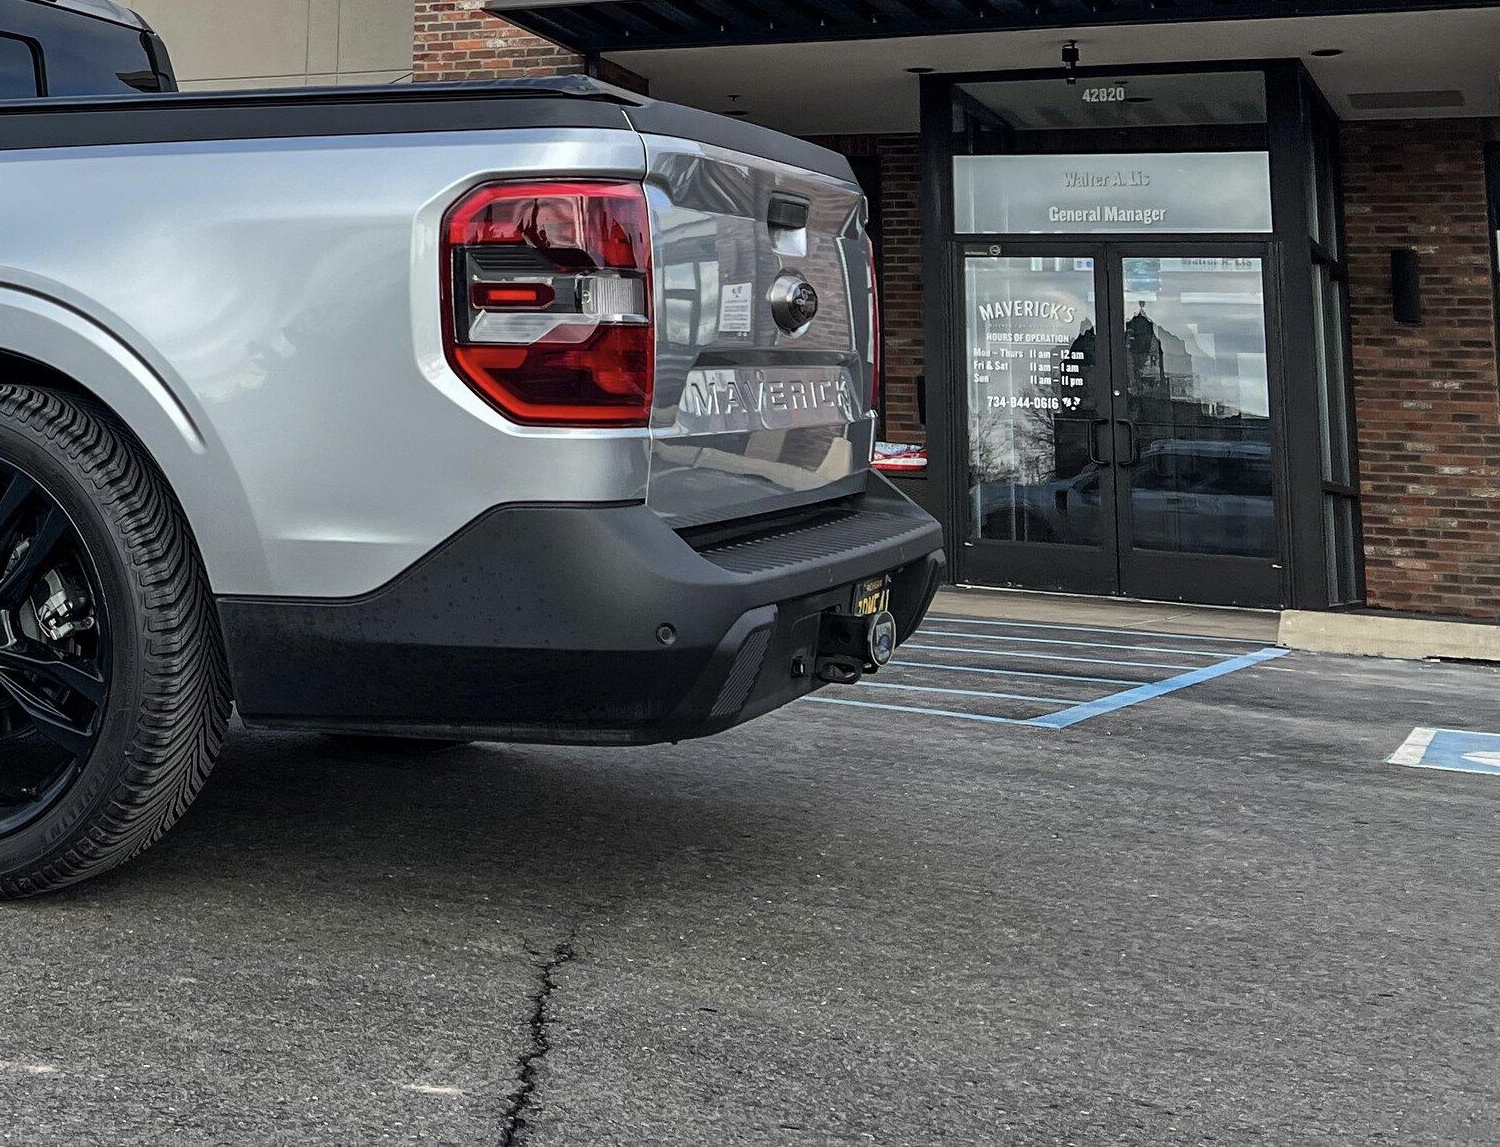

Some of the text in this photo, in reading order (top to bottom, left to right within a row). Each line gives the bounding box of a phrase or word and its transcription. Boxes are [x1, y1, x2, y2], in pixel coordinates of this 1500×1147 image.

[1048, 206, 1167, 225] General Manager
[979, 300, 1076, 323] MAVERICK'S
[987, 333, 1070, 343] HOURS OF OPERATION
[1000, 348, 1024, 358] Thurs
[1038, 351, 1051, 359] am
[1060, 349, 1070, 359] 12
[1071, 352, 1084, 360] am
[973, 361, 984, 370] Fri
[986, 361, 994, 371] &
[995, 361, 1008, 371] Sat
[1038, 364, 1051, 372] am
[1066, 364, 1079, 373] am
[974, 373, 990, 383] Sun
[1038, 376, 1052, 385] am
[1070, 377, 1083, 388] pm
[690, 379, 853, 417] MAVERICK
